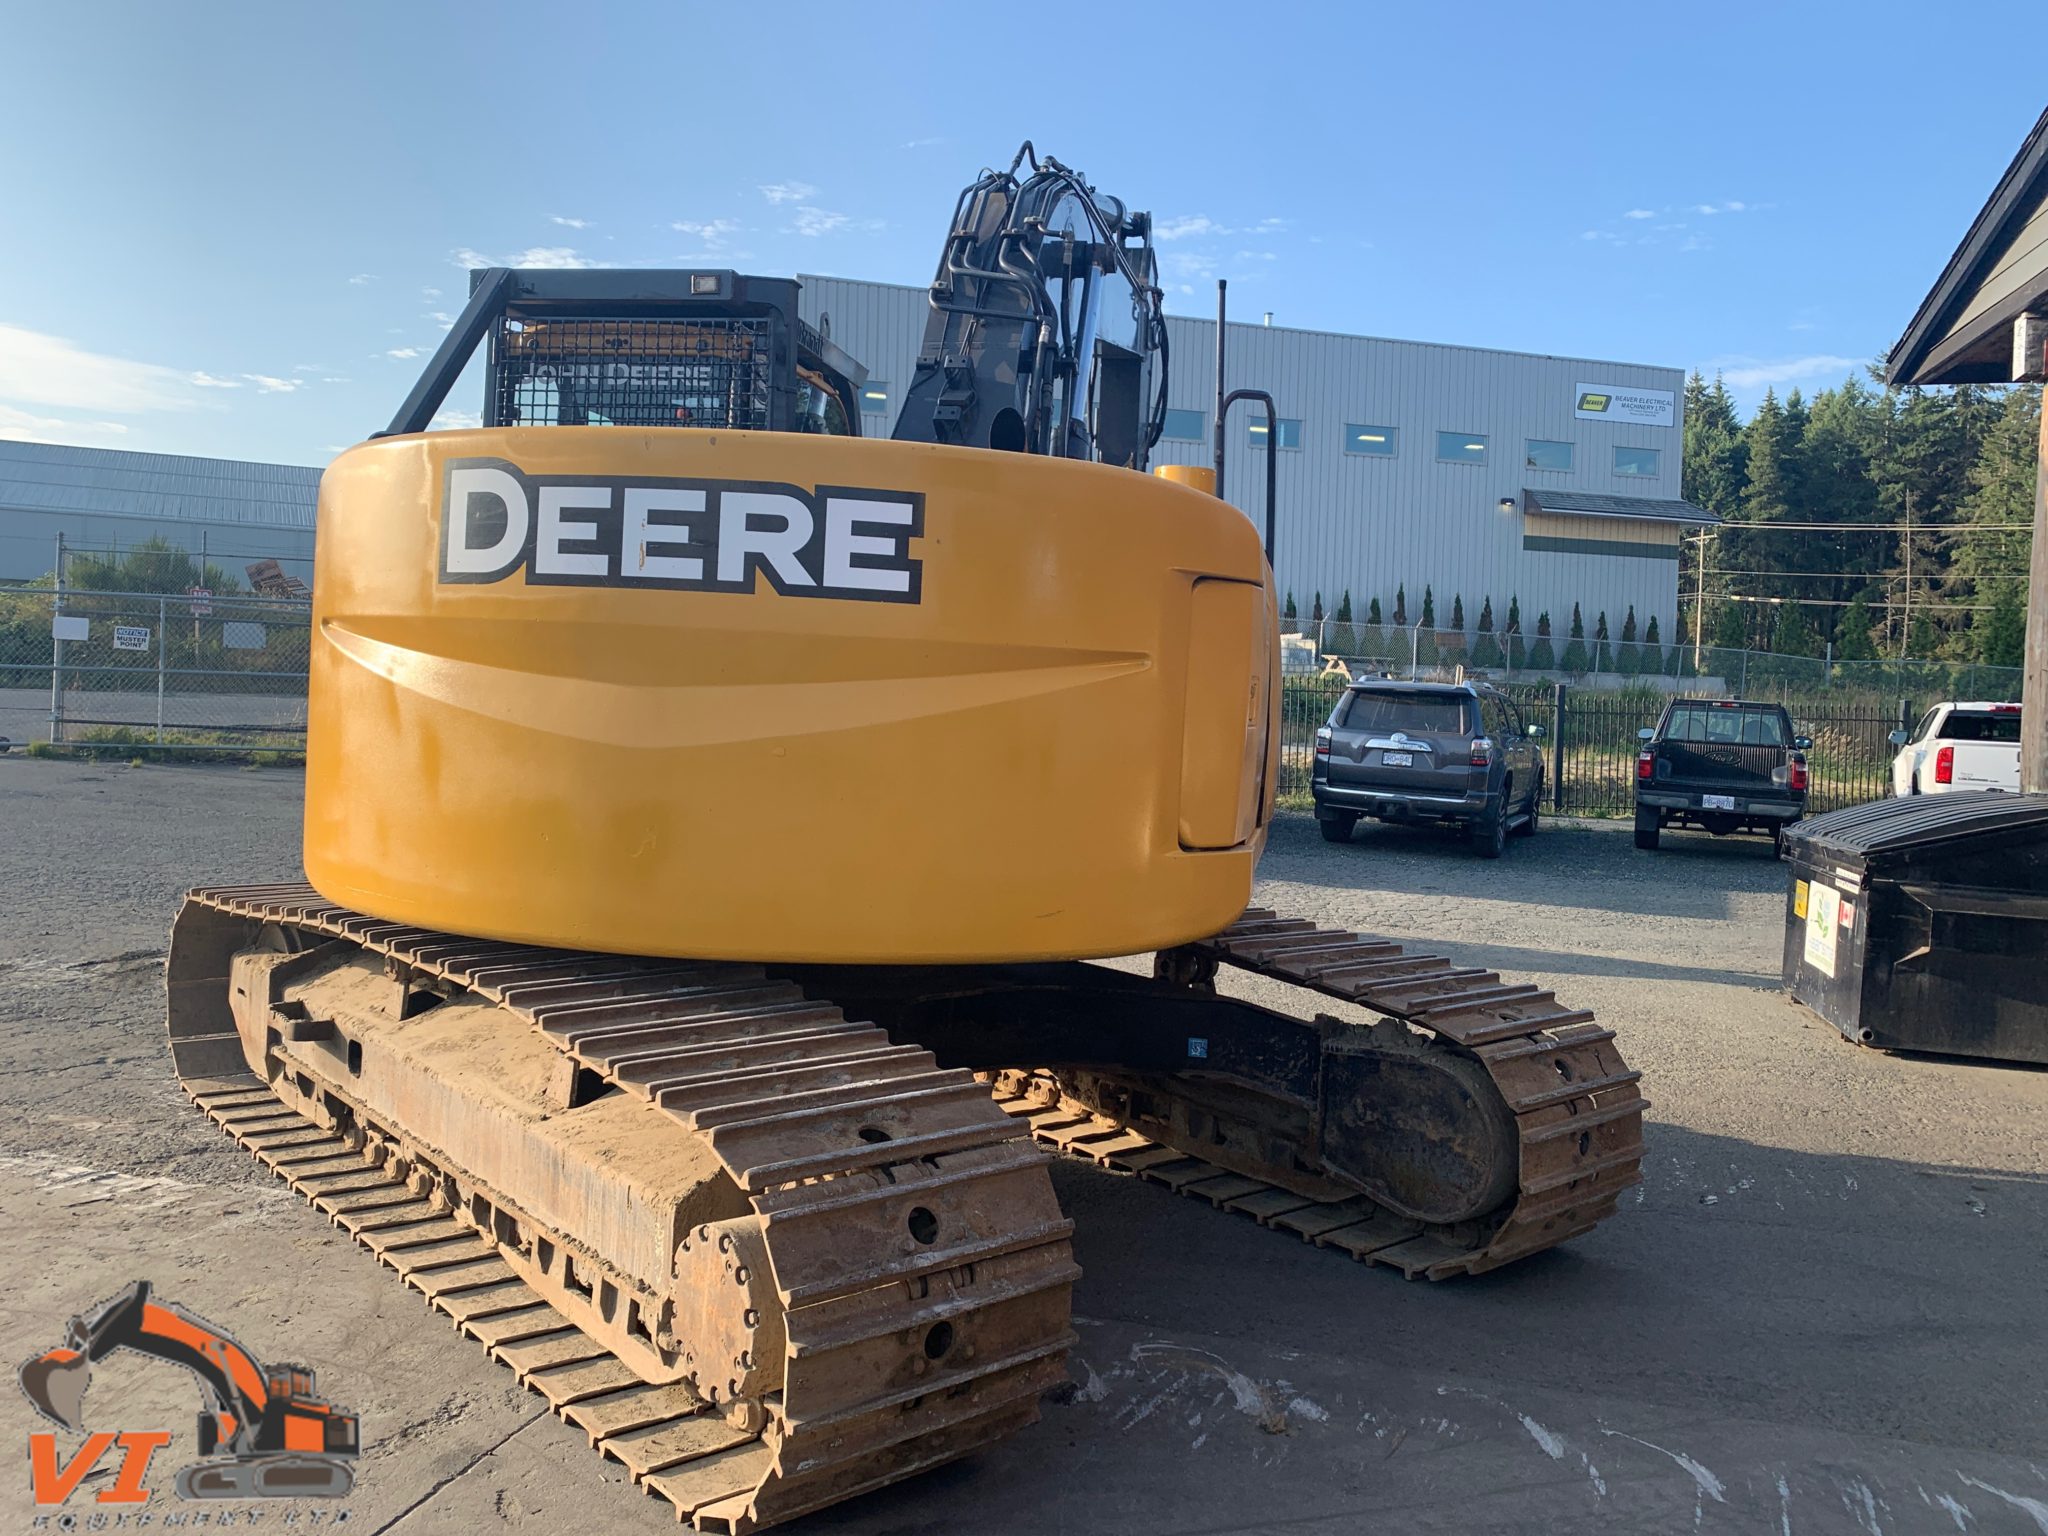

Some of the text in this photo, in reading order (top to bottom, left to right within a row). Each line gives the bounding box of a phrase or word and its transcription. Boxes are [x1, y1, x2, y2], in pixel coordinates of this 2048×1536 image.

[521, 362, 711, 387] JOHN DEERE
[1638, 397, 1673, 406] ELECTRICAL
[444, 467, 916, 593] DEERE
[117, 628, 147, 636] NOTICE
